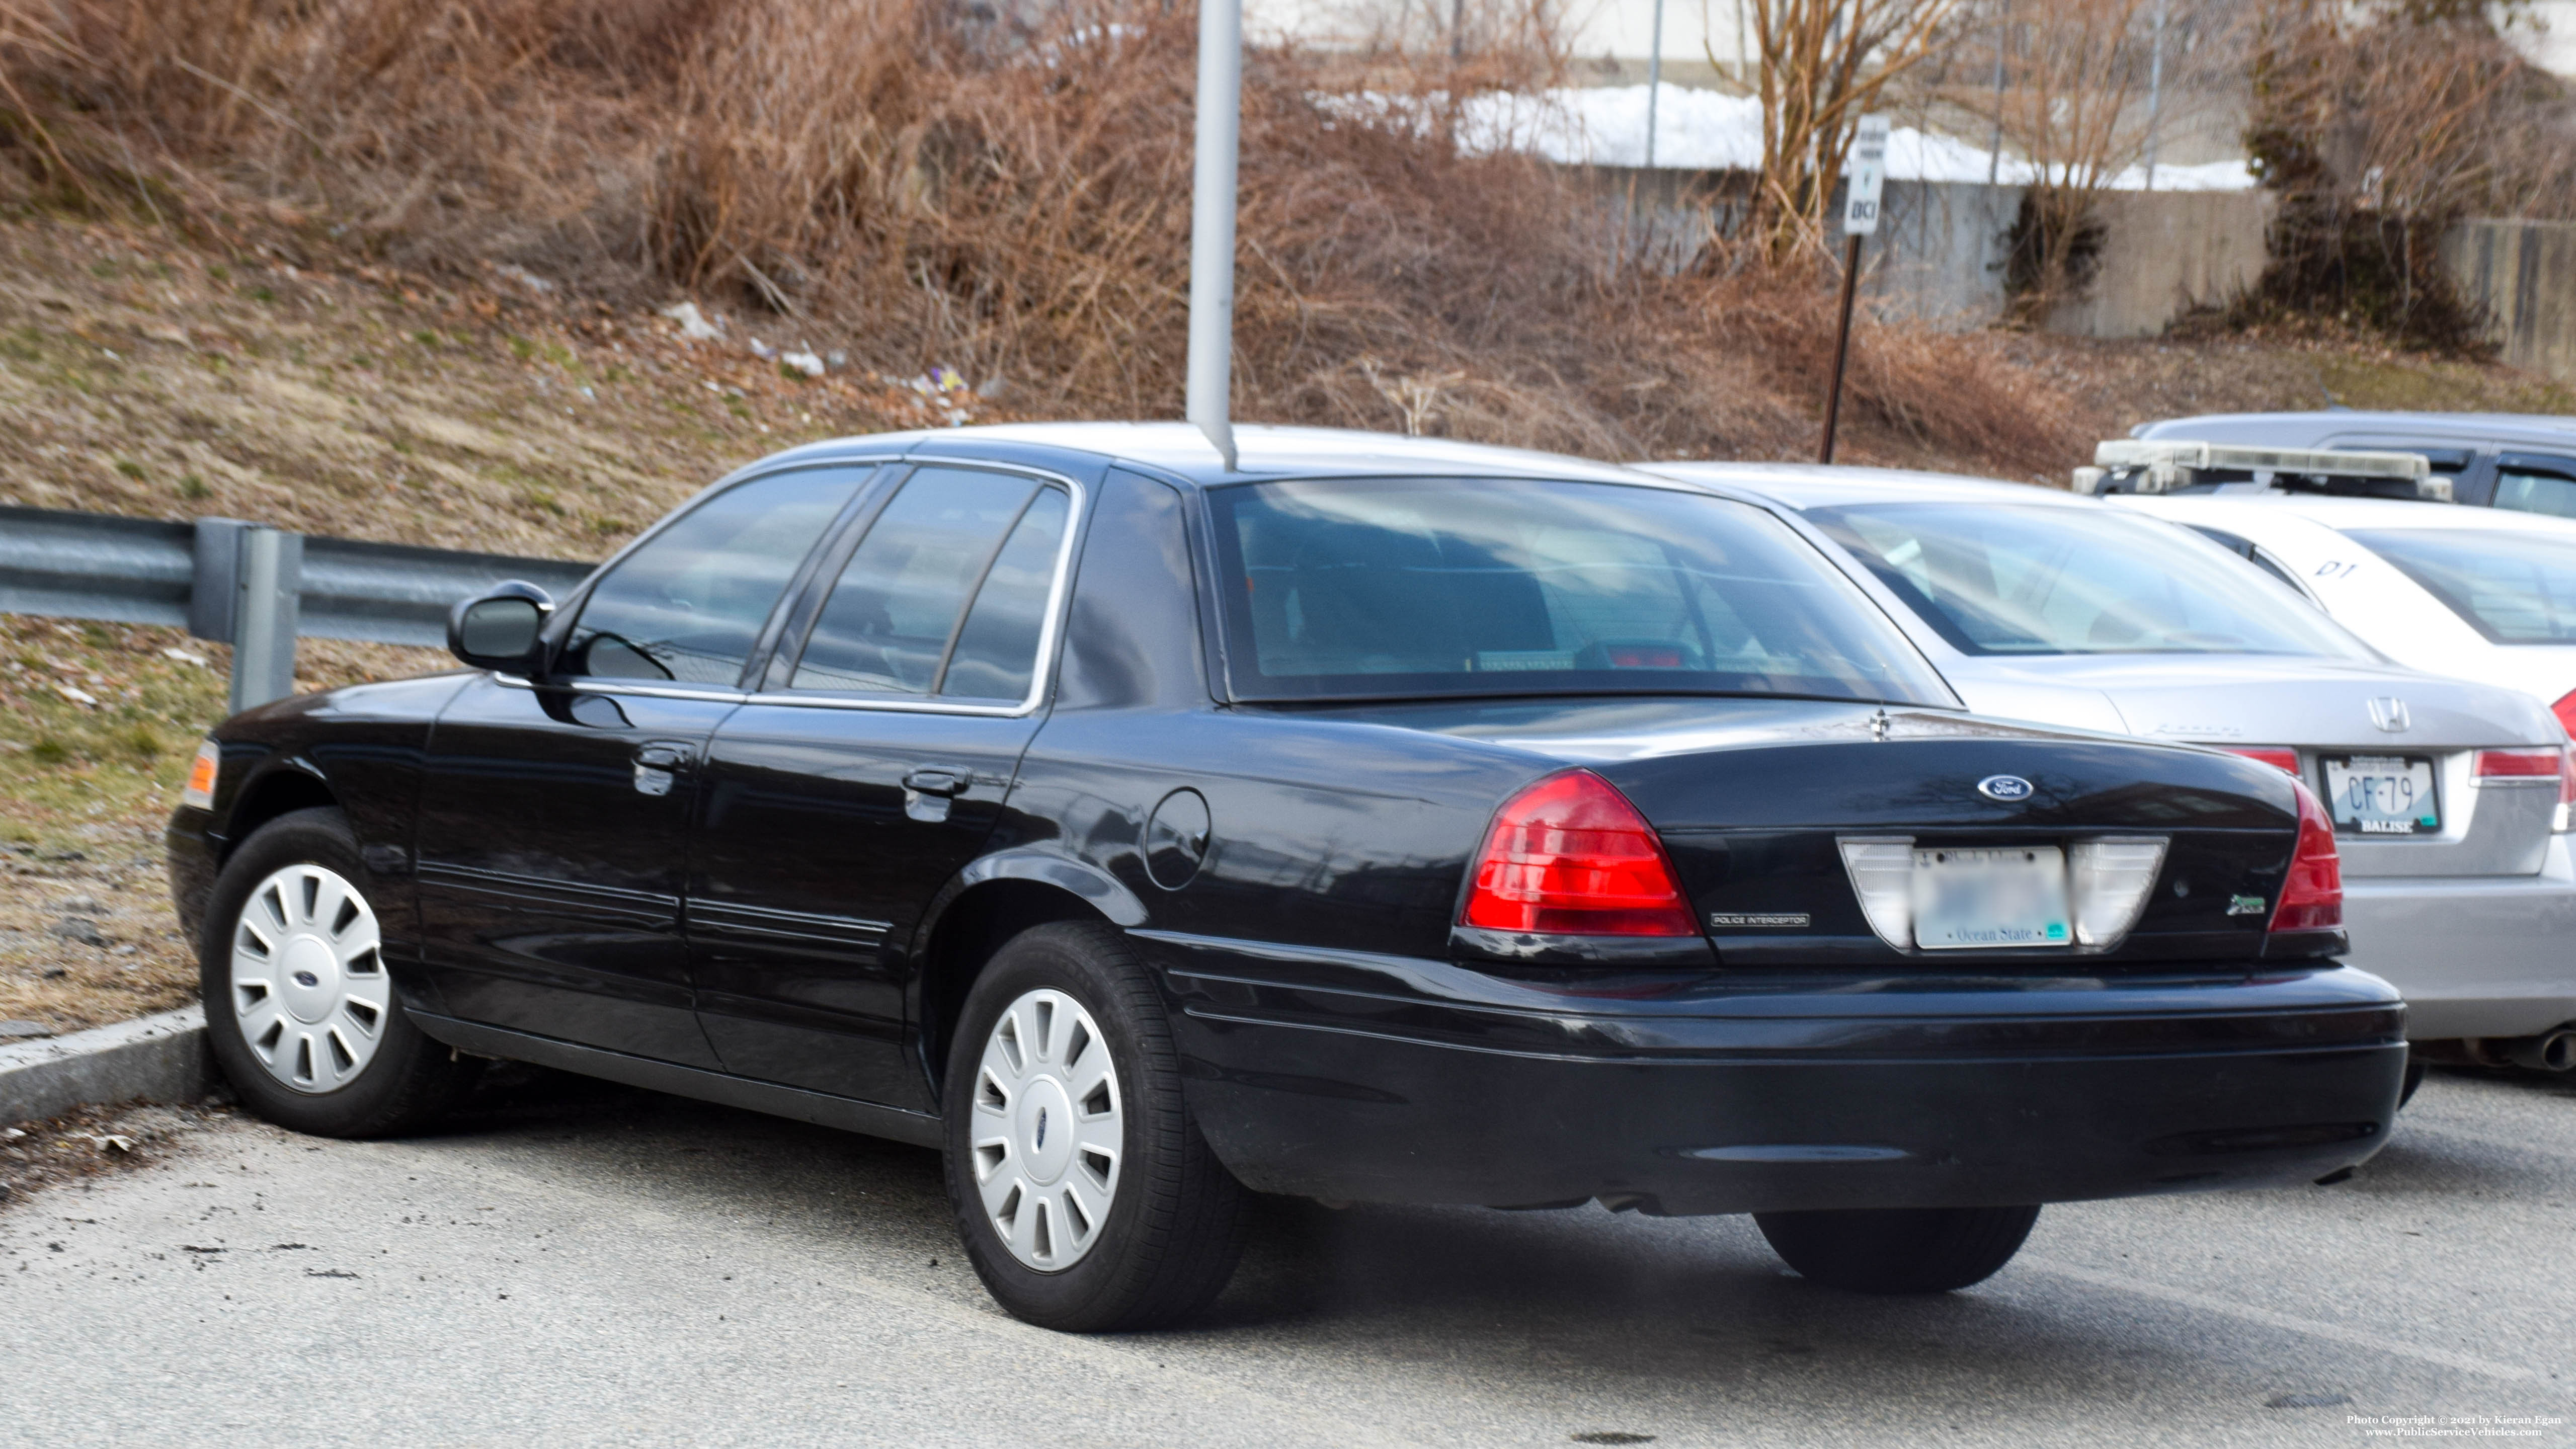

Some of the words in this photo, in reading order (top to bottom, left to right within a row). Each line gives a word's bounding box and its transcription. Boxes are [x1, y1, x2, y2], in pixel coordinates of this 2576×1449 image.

[2349, 776, 2412, 810] CF-79
[2361, 820, 2413, 833] BALISE
[1957, 929, 1996, 942] Ocean
[1999, 928, 2033, 941] State
